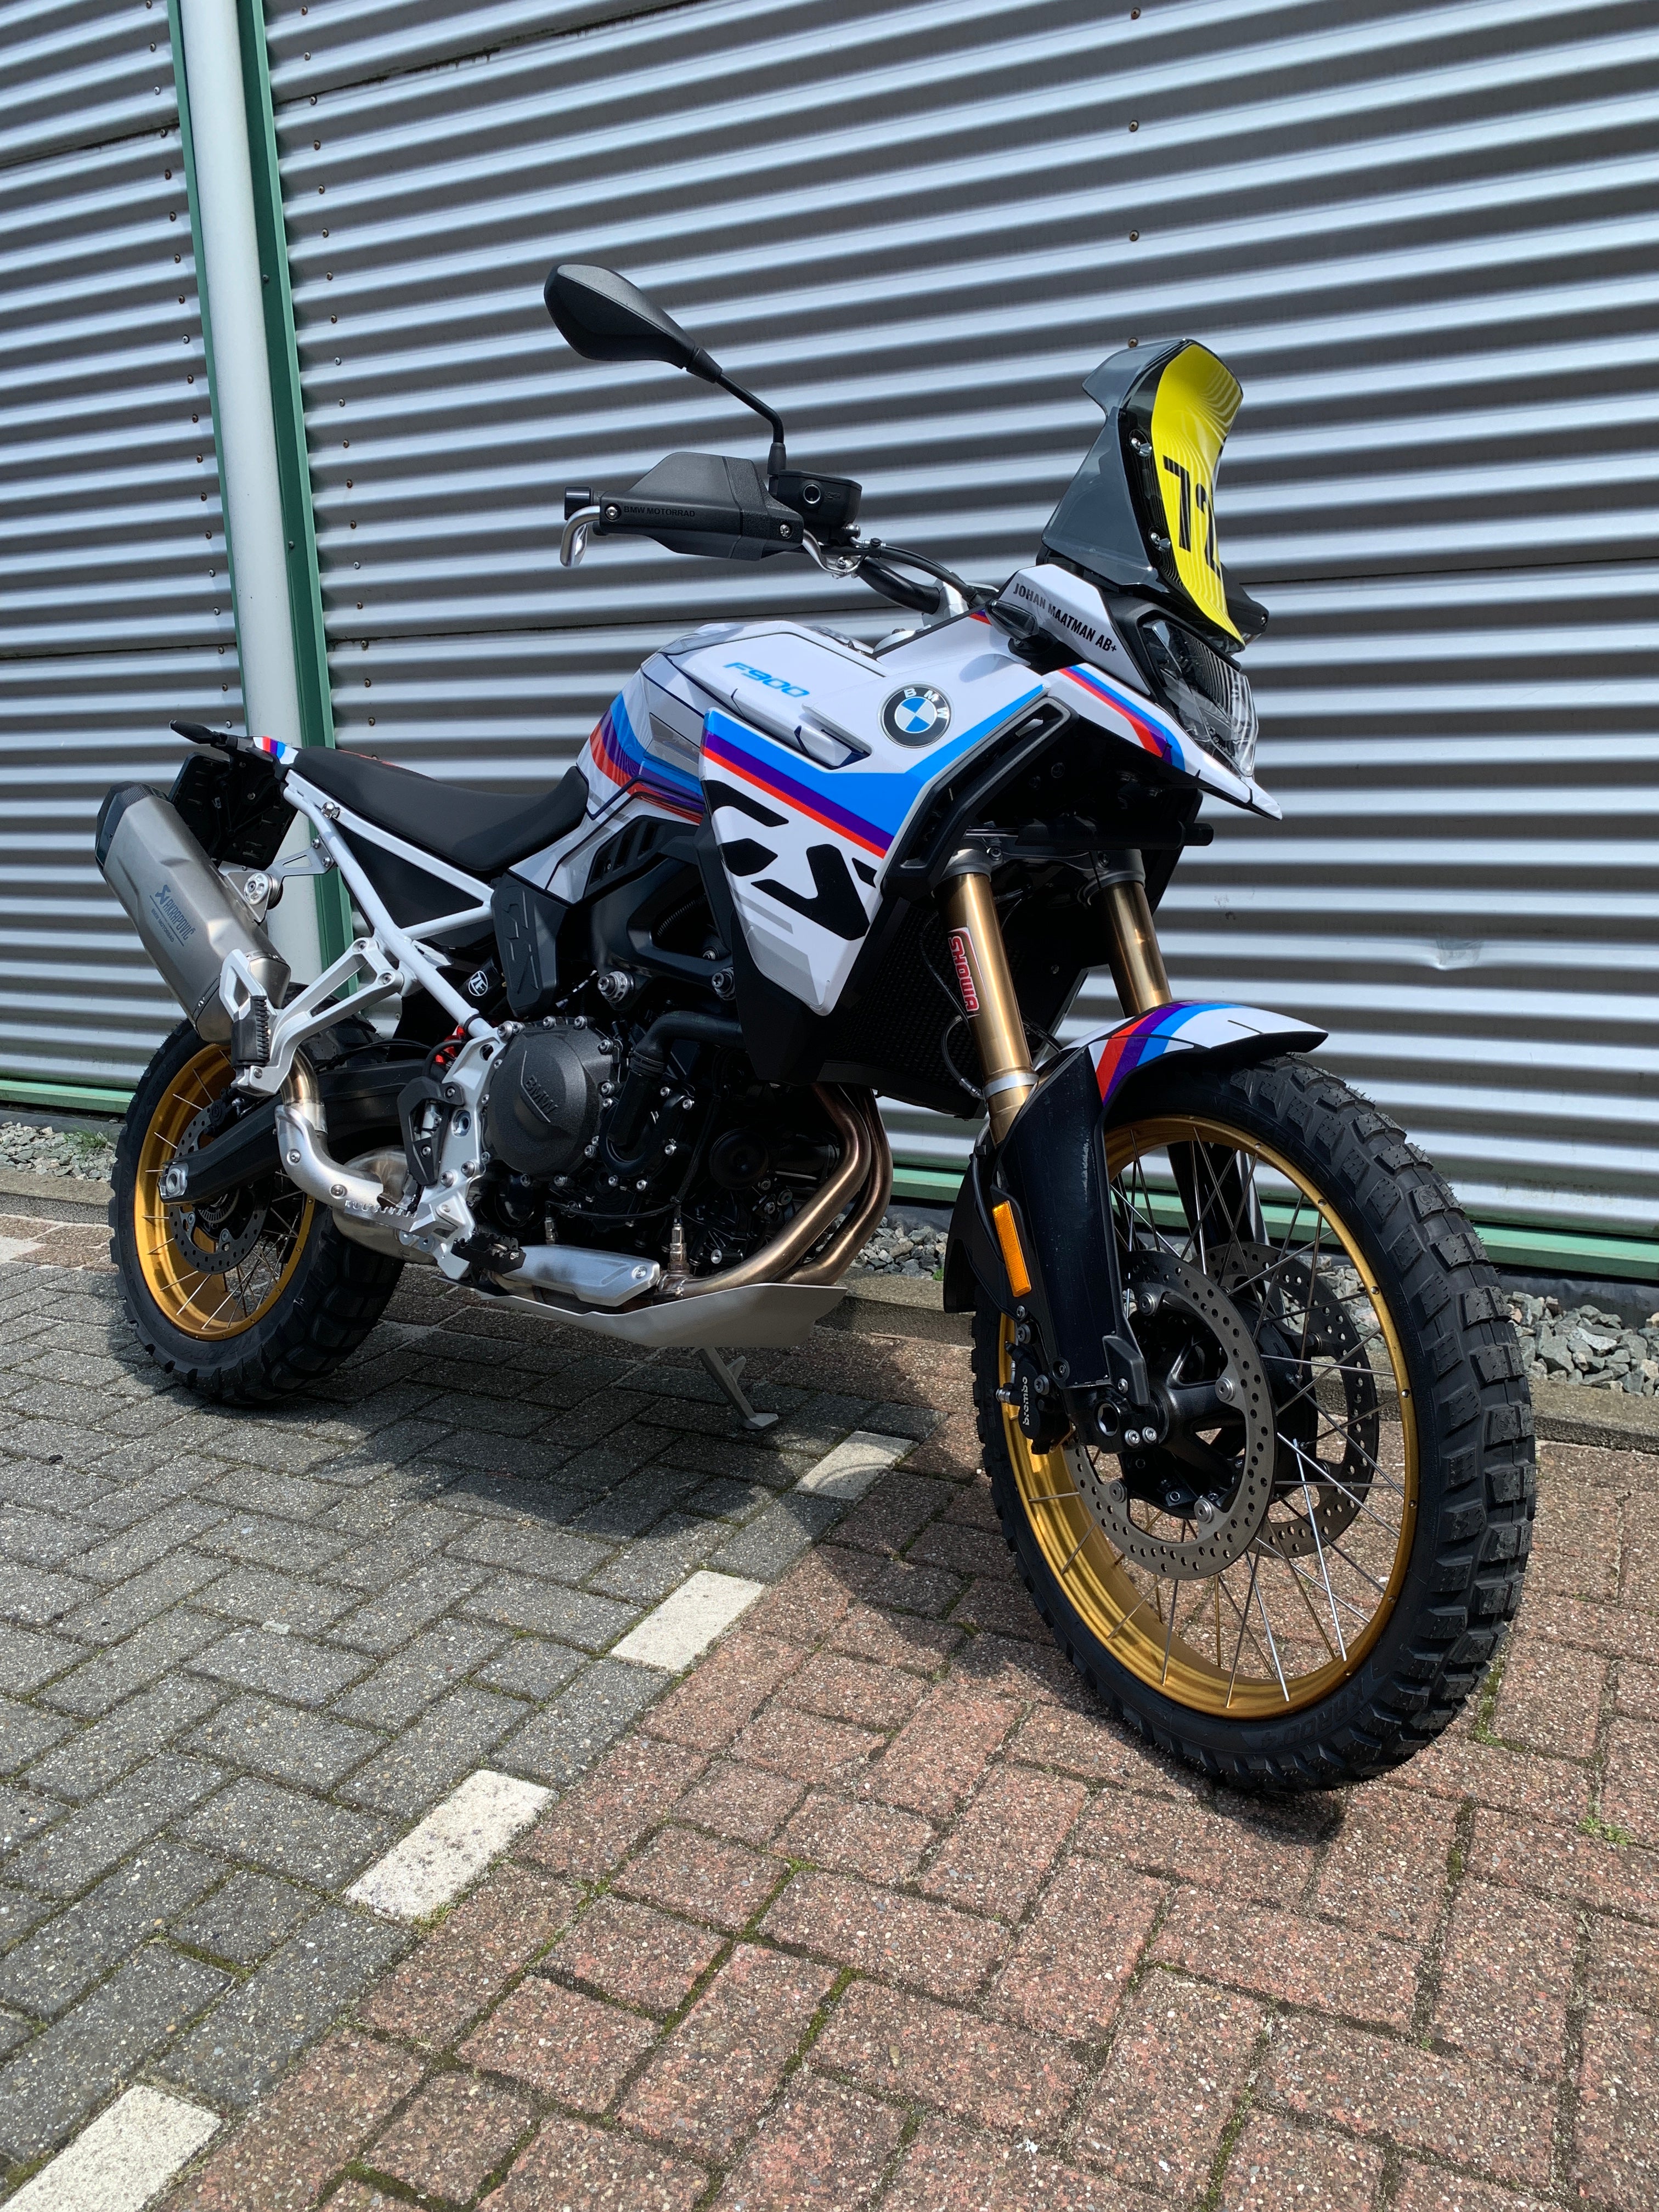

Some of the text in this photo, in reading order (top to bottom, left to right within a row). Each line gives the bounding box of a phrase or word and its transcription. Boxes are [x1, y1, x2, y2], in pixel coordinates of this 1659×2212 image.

[624, 506, 695, 517] BMW MOTORRAD
[1013, 583, 1117, 652] JOHAN MAATMAN AB+
[722, 662, 810, 698] F900
[904, 687, 950, 720] BMW
[469, 970, 488, 996] ZF
[948, 935, 980, 1012] SHOWA
[525, 1075, 559, 1115] BMW
[1021, 1376, 1030, 1426] brembo
